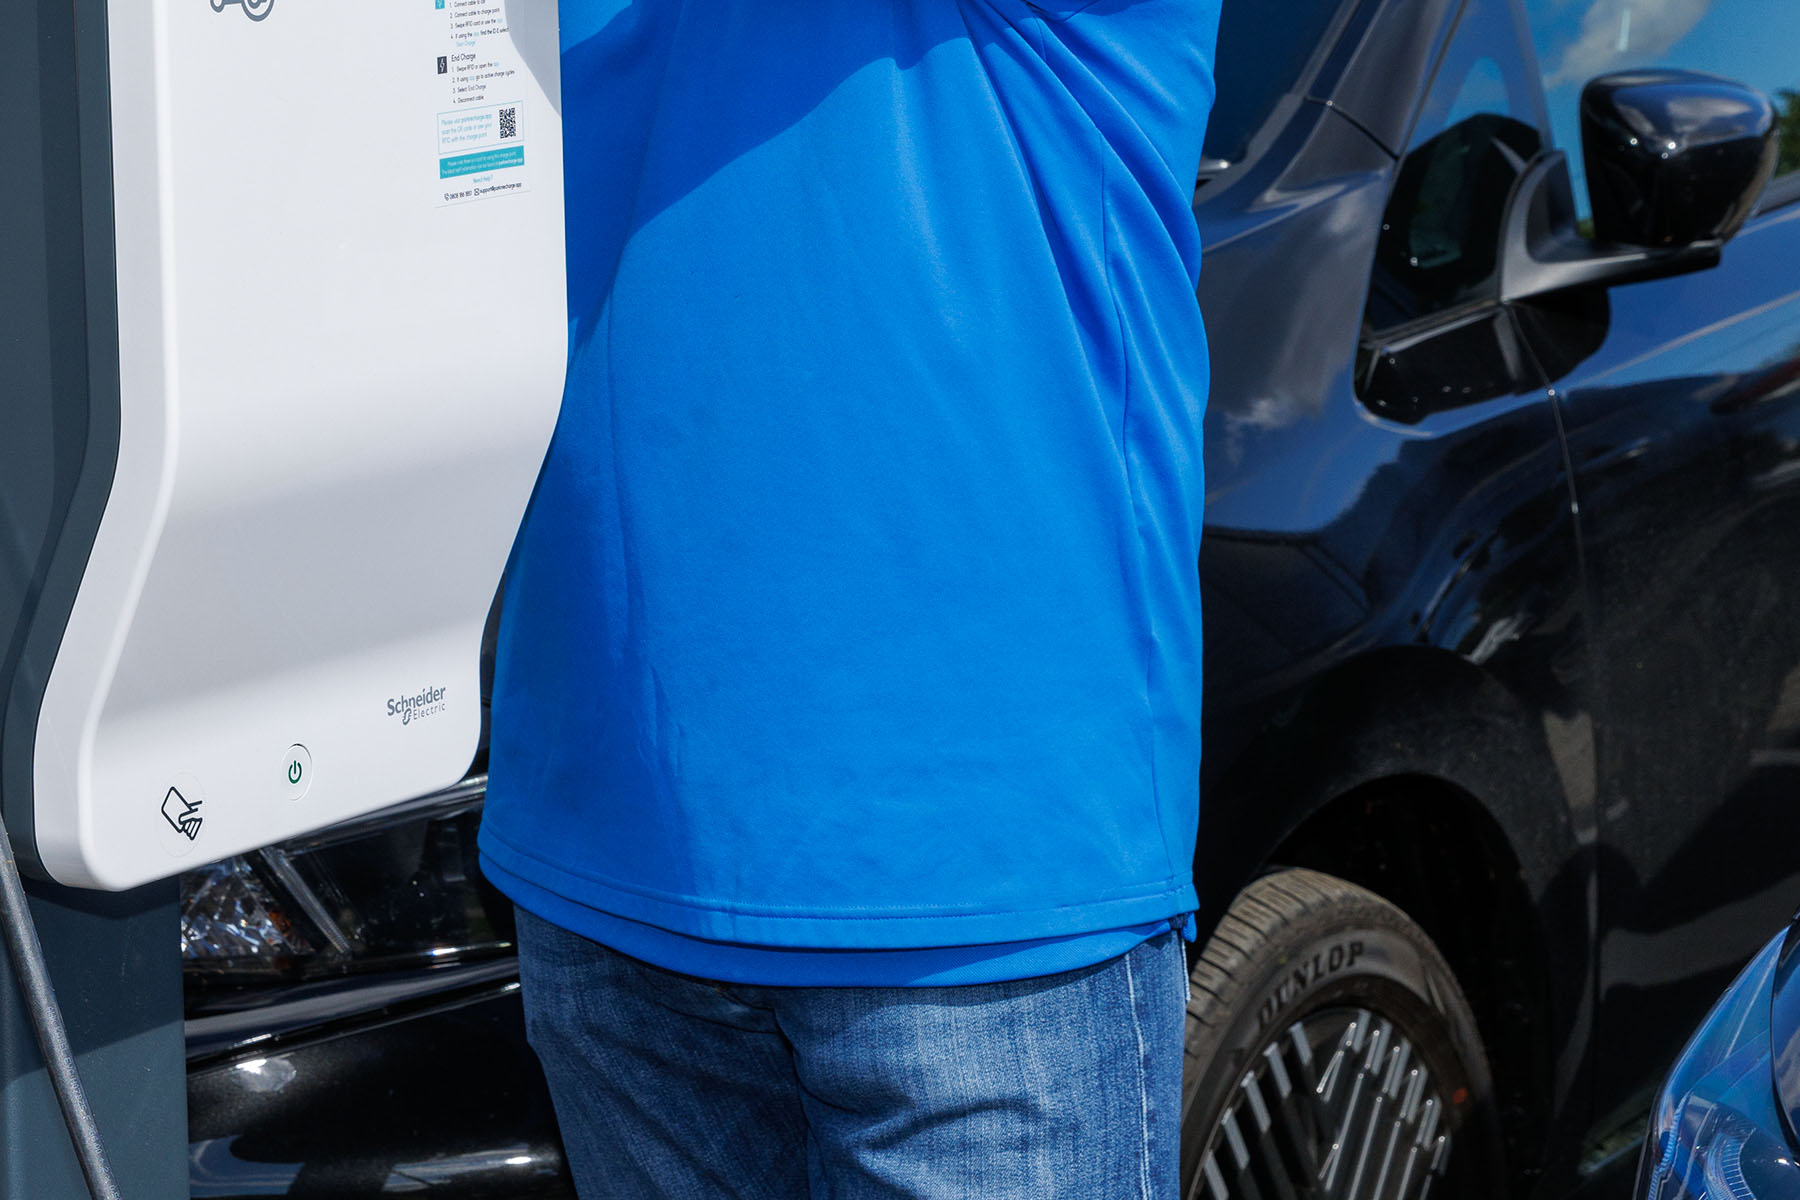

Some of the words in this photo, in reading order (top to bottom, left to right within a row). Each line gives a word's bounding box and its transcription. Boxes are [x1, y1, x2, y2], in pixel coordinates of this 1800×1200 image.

[451, 54, 460, 62] End
[460, 51, 476, 63] Charge
[387, 686, 446, 716] Schneider
[413, 703, 445, 720] Electric
[1255, 940, 1365, 1031] DUNLOP
